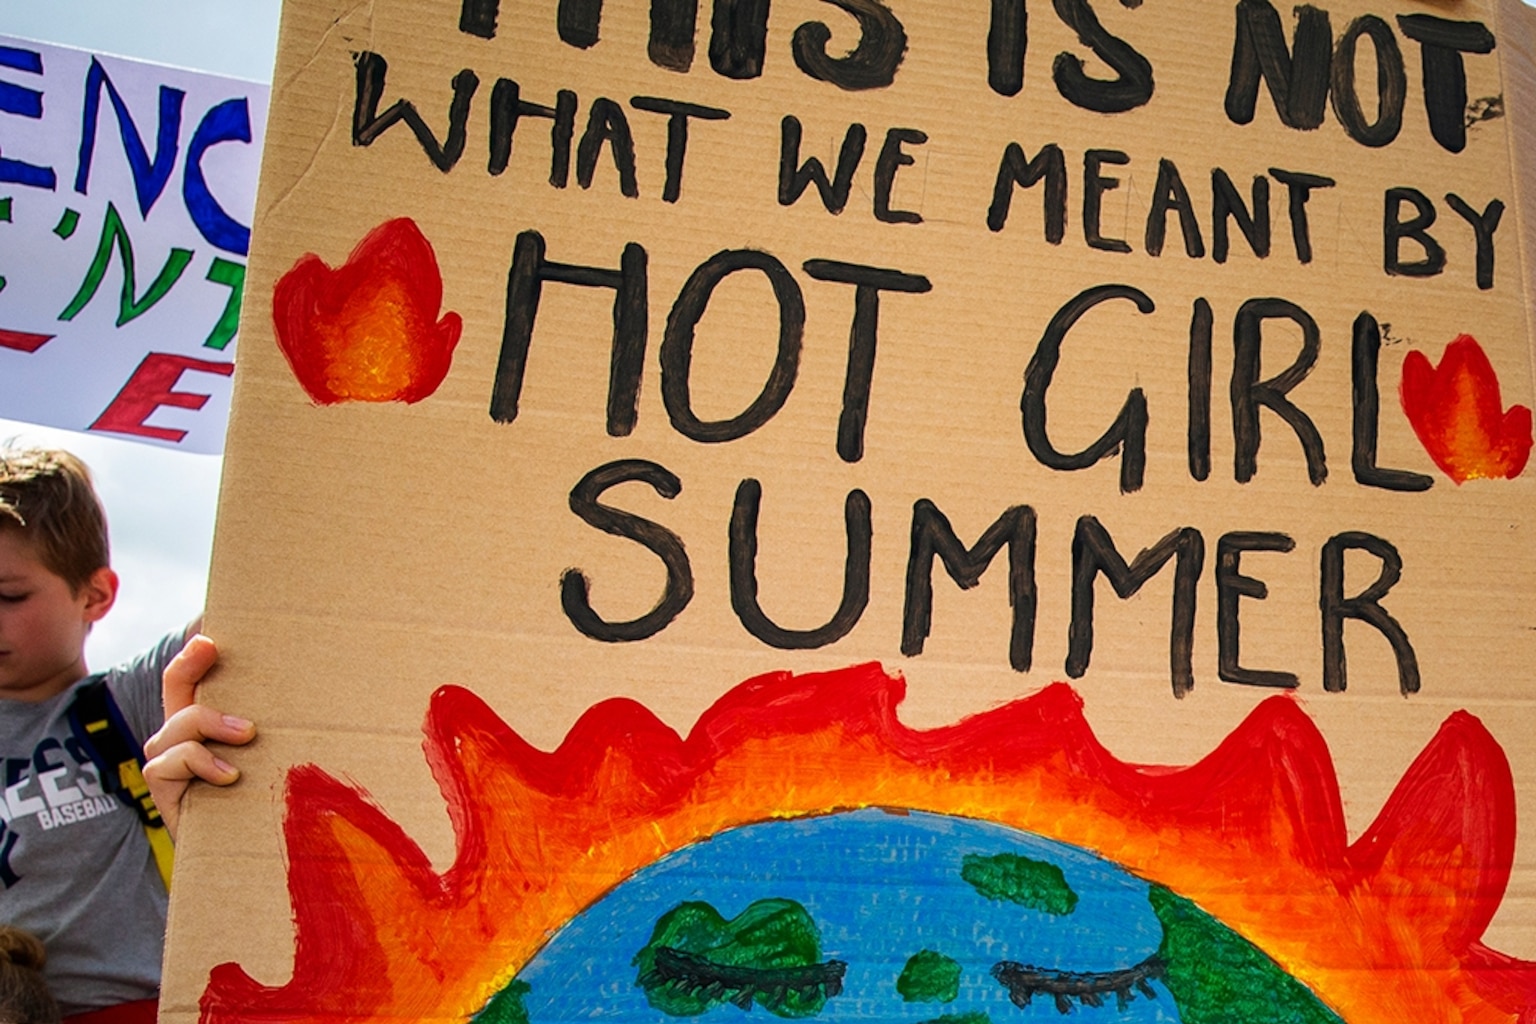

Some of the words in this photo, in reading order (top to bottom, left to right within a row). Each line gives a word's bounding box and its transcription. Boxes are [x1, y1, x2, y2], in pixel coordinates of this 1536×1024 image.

[353, 51, 731, 203] WHAT
[778, 115, 928, 223] WE
[988, 143, 1335, 264] MEANT
[1384, 187, 1505, 289] BY
[988, 0, 1154, 113] IS
[1224, 0, 1496, 153] NOT
[490, 229, 932, 462] HOT
[1021, 285, 1433, 493] GIRL
[560, 459, 1422, 698] SUMMER
[37, 795, 118, 831] BASEBALL
